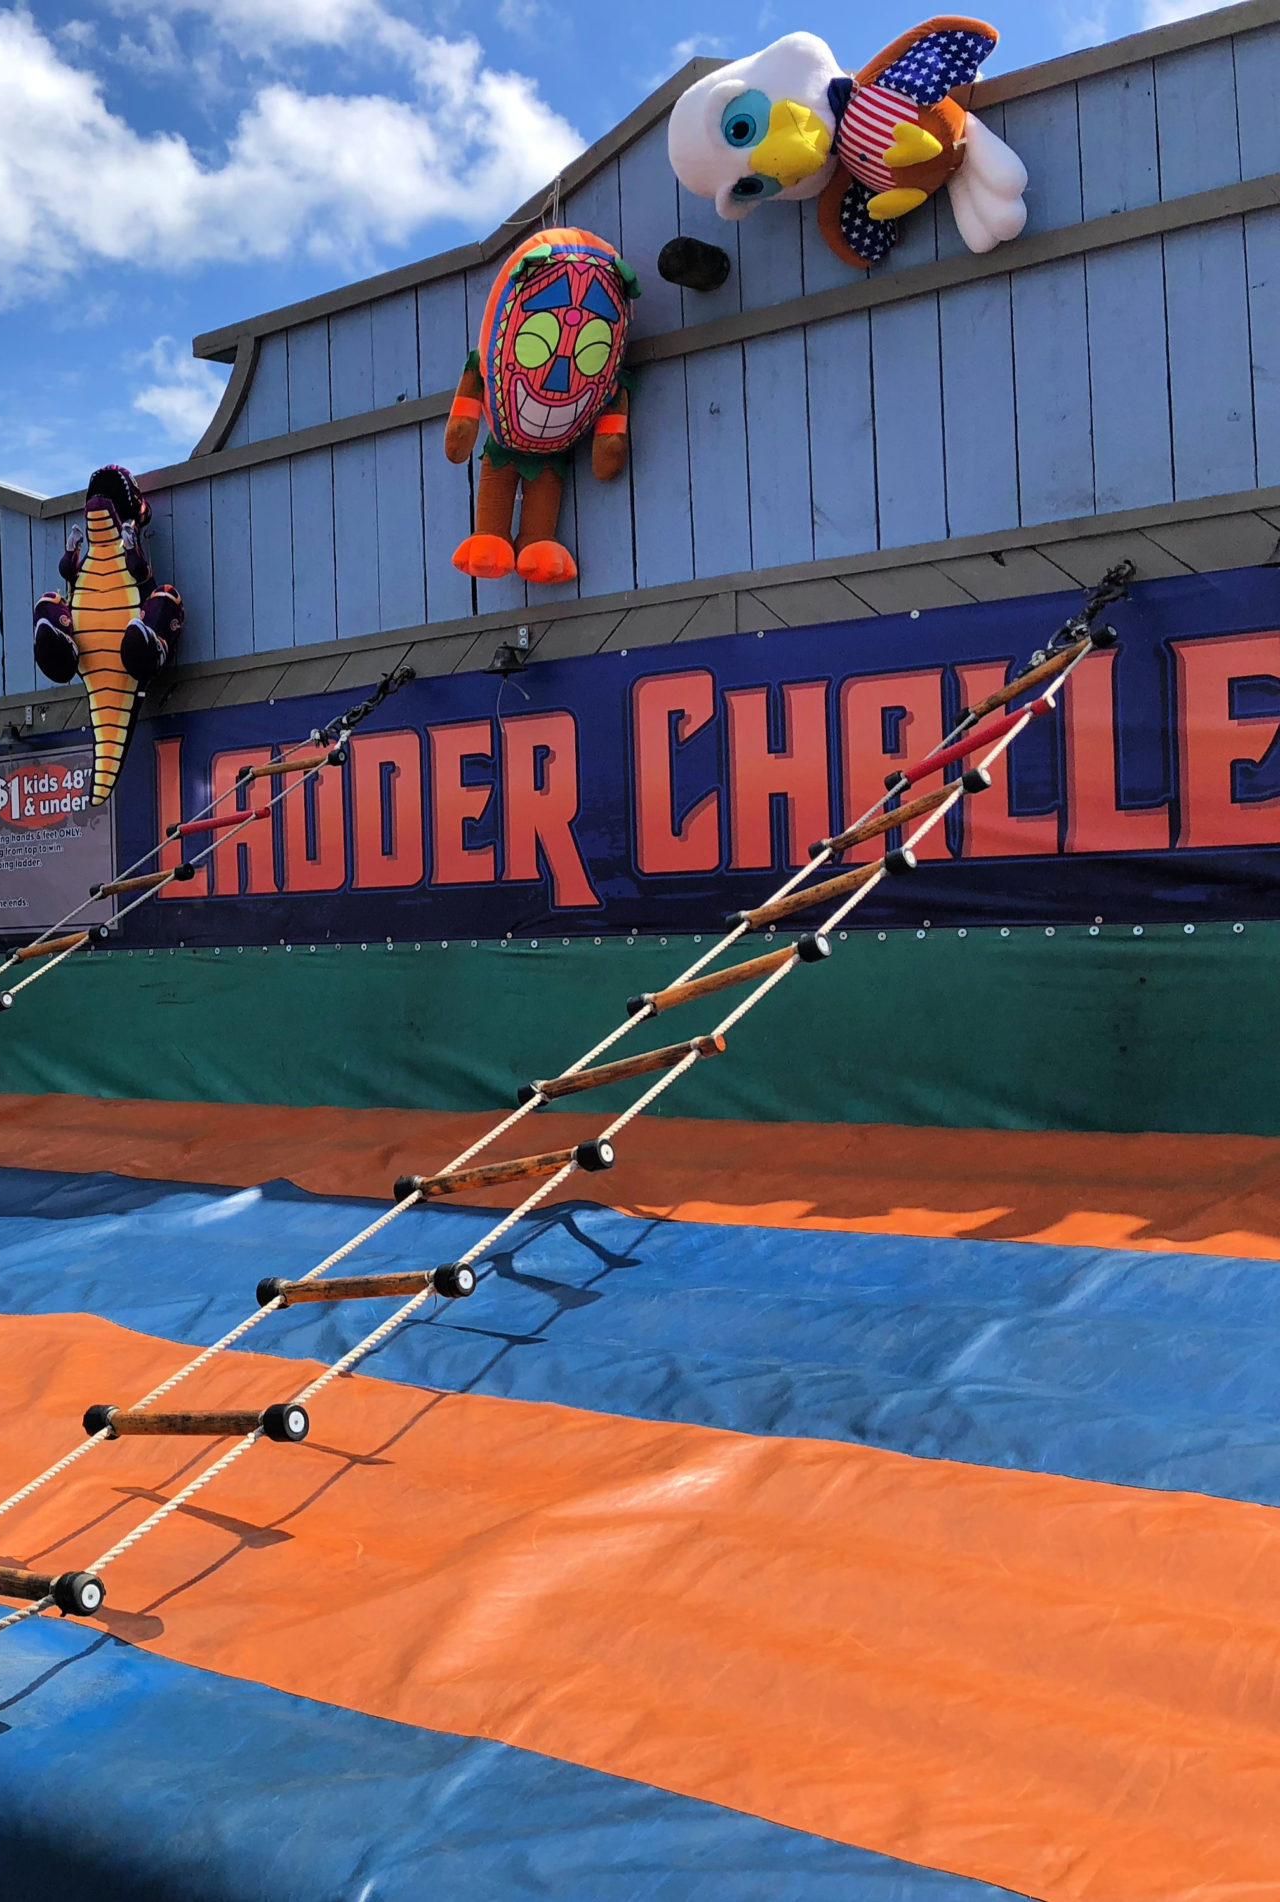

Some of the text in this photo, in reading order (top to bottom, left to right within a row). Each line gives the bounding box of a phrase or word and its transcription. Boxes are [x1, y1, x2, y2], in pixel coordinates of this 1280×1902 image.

[23, 773, 58, 795] kids
[24, 792, 90, 817] & under
[154, 711, 601, 907] LADDER
